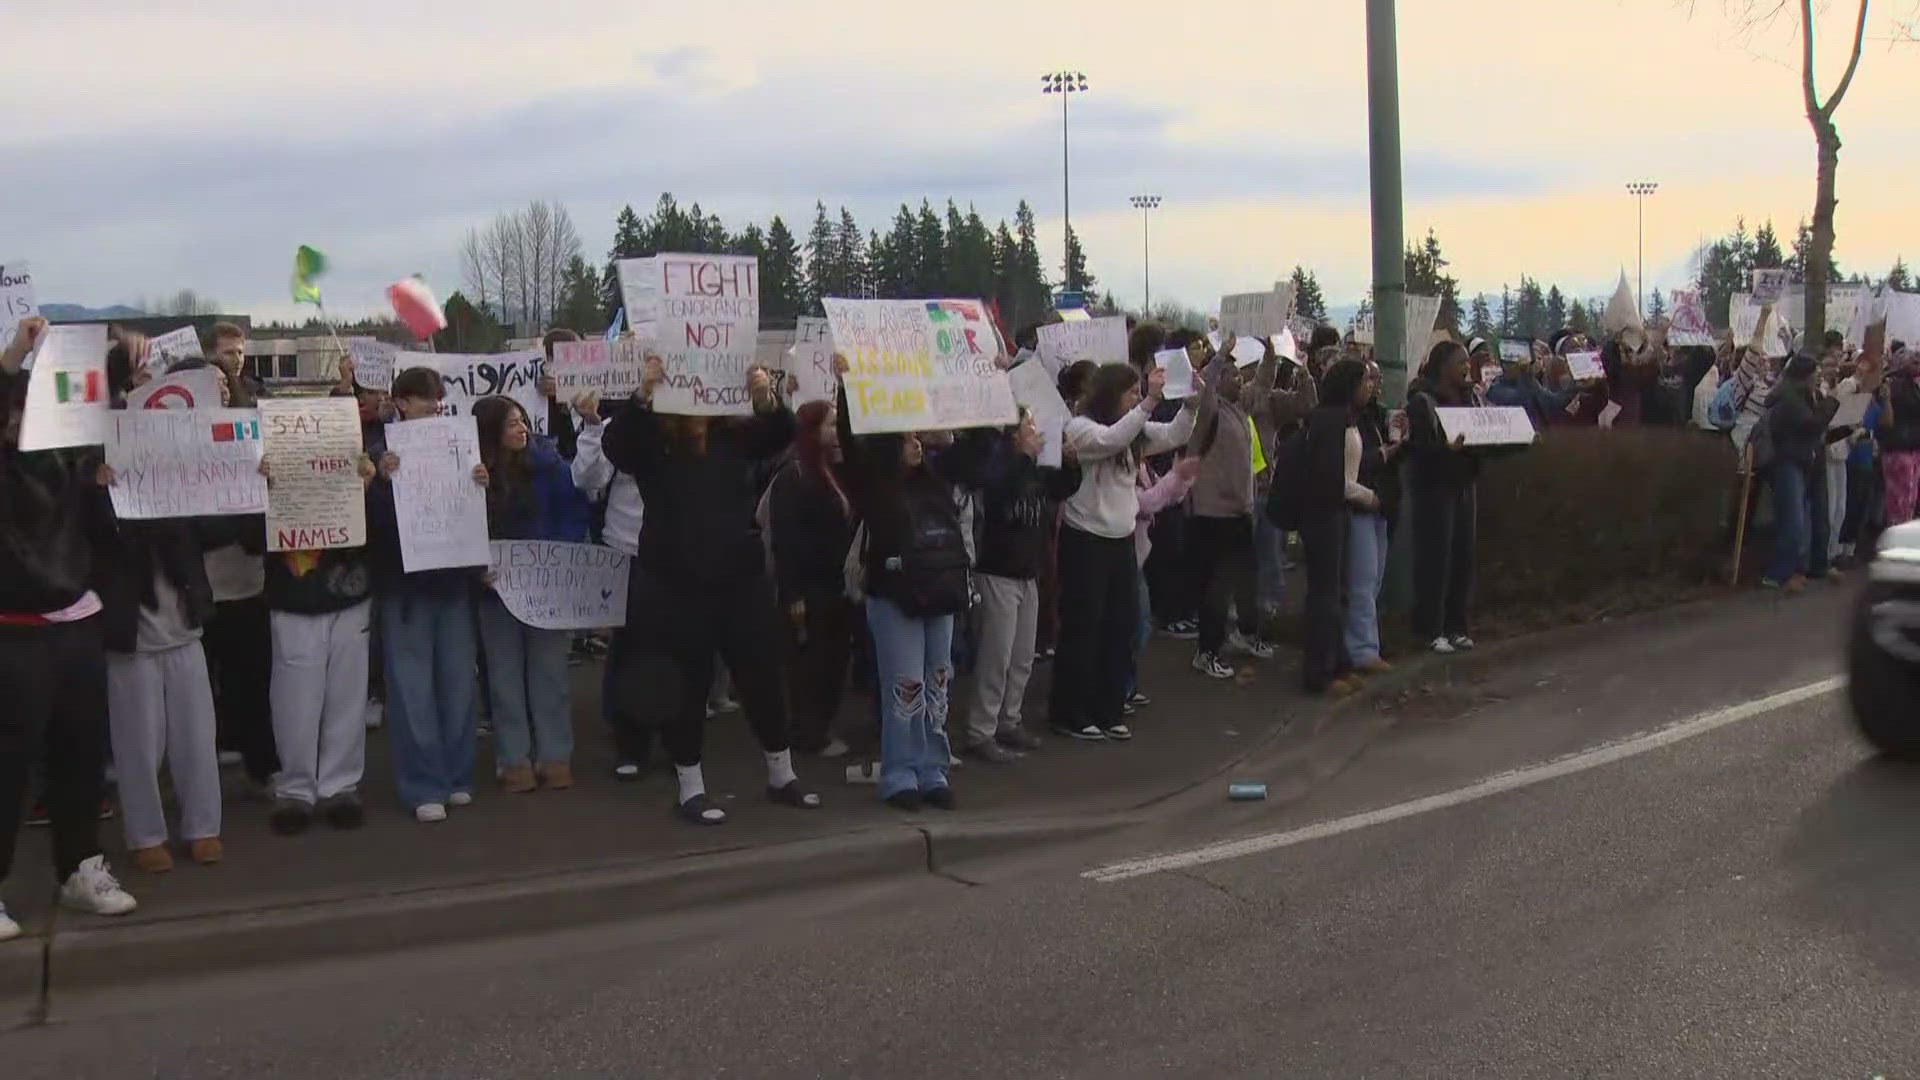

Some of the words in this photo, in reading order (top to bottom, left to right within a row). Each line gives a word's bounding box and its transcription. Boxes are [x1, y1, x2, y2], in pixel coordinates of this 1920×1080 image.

[664, 261, 756, 297] FIGHT
[685, 321, 735, 350] NOT
[936, 329, 983, 354] OUR
[663, 374, 704, 388] VIVA
[693, 385, 752, 406] MEXICO
[272, 415, 322, 434] SAY
[306, 458, 352, 472] THEIR
[278, 527, 350, 549] NAMES
[494, 543, 562, 568] JESUS
